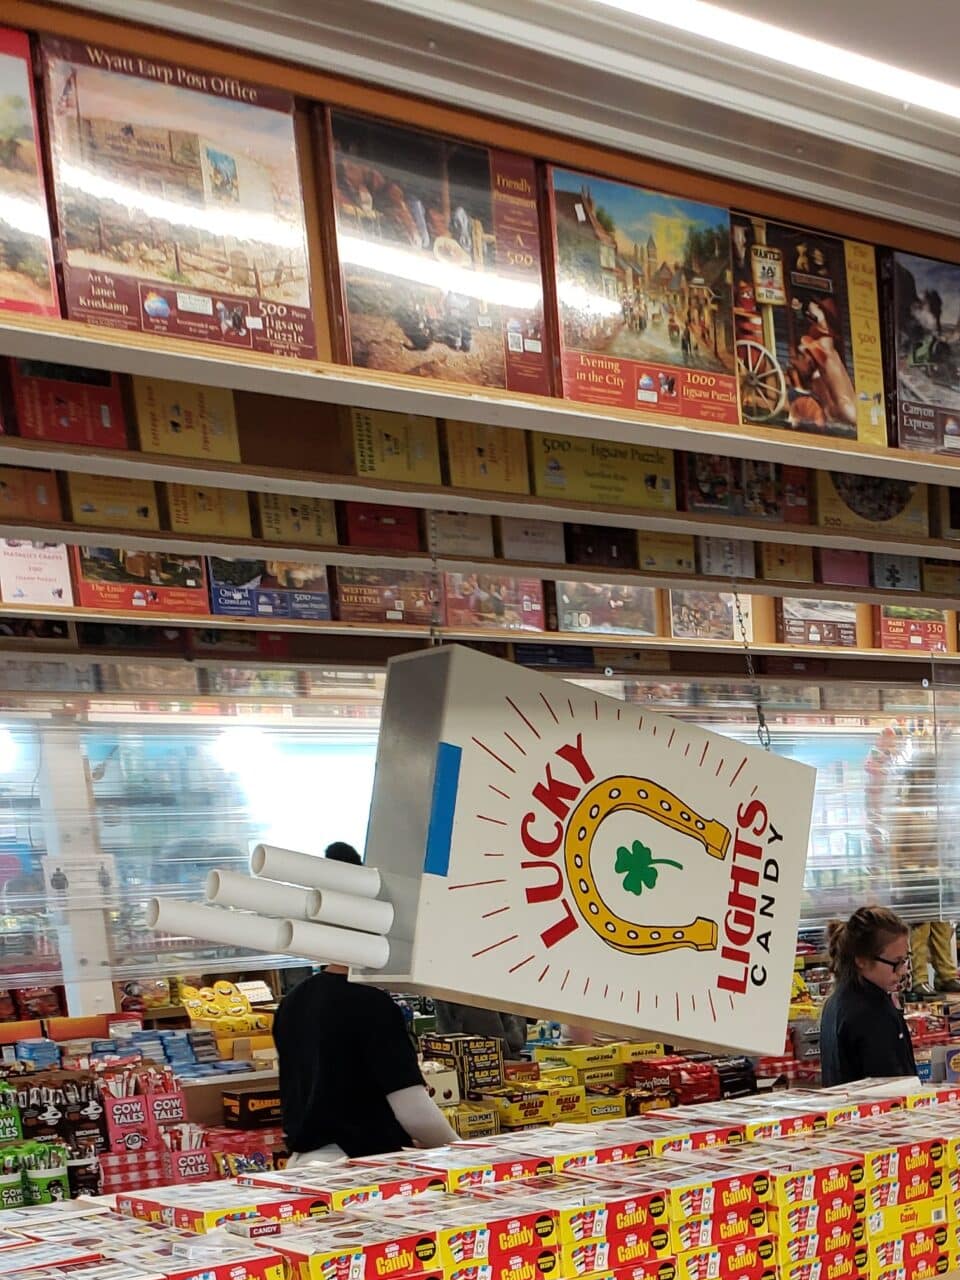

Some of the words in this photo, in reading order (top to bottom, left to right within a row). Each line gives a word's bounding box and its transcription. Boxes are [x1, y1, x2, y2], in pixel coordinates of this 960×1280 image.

[86, 46, 133, 73] Wyatt
[139, 59, 172, 85] Earp
[177, 68, 206, 89] Post
[211, 78, 257, 101] Office
[507, 251, 532, 266] 500
[88, 273, 102, 283] Art
[105, 275, 113, 285] by
[91, 286, 116, 298] Janet
[259, 302, 287, 316] 500
[266, 319, 304, 333] Jigsaw
[267, 330, 304, 344] Puzzle
[858, 334, 876, 345] 500
[579, 355, 621, 374] Evening
[576, 371, 584, 380] in
[587, 372, 603, 383] the
[605, 374, 625, 388] City
[686, 372, 716, 386] 1000
[682, 386, 709, 400] Jigsaw
[711, 390, 736, 402] Puzzle
[902, 403, 935, 418] Canyon
[903, 416, 935, 431] Express
[543, 438, 572, 451] 500
[927, 624, 943, 633] 550
[520, 733, 596, 949] LUCKY
[717, 800, 768, 995] LIGHTS
[750, 824, 784, 986] CANDY
[153, 1098, 182, 1111] COW
[519, 1101, 544, 1111] MALLO
[556, 1095, 580, 1105] MALLO
[112, 1102, 142, 1115] COW
[524, 1109, 539, 1117] CUP
[561, 1103, 576, 1111] CUP
[591, 1106, 620, 1116] Chuckles
[113, 1112, 144, 1125] TALES
[154, 1108, 183, 1121] TALES
[177, 1155, 207, 1167] COW
[179, 1163, 209, 1177] TALES
[900, 1210, 918, 1222] Candy
[252, 1226, 278, 1234] CANDY
[499, 1227, 534, 1250] Candy
[828, 1257, 852, 1279] Candy
